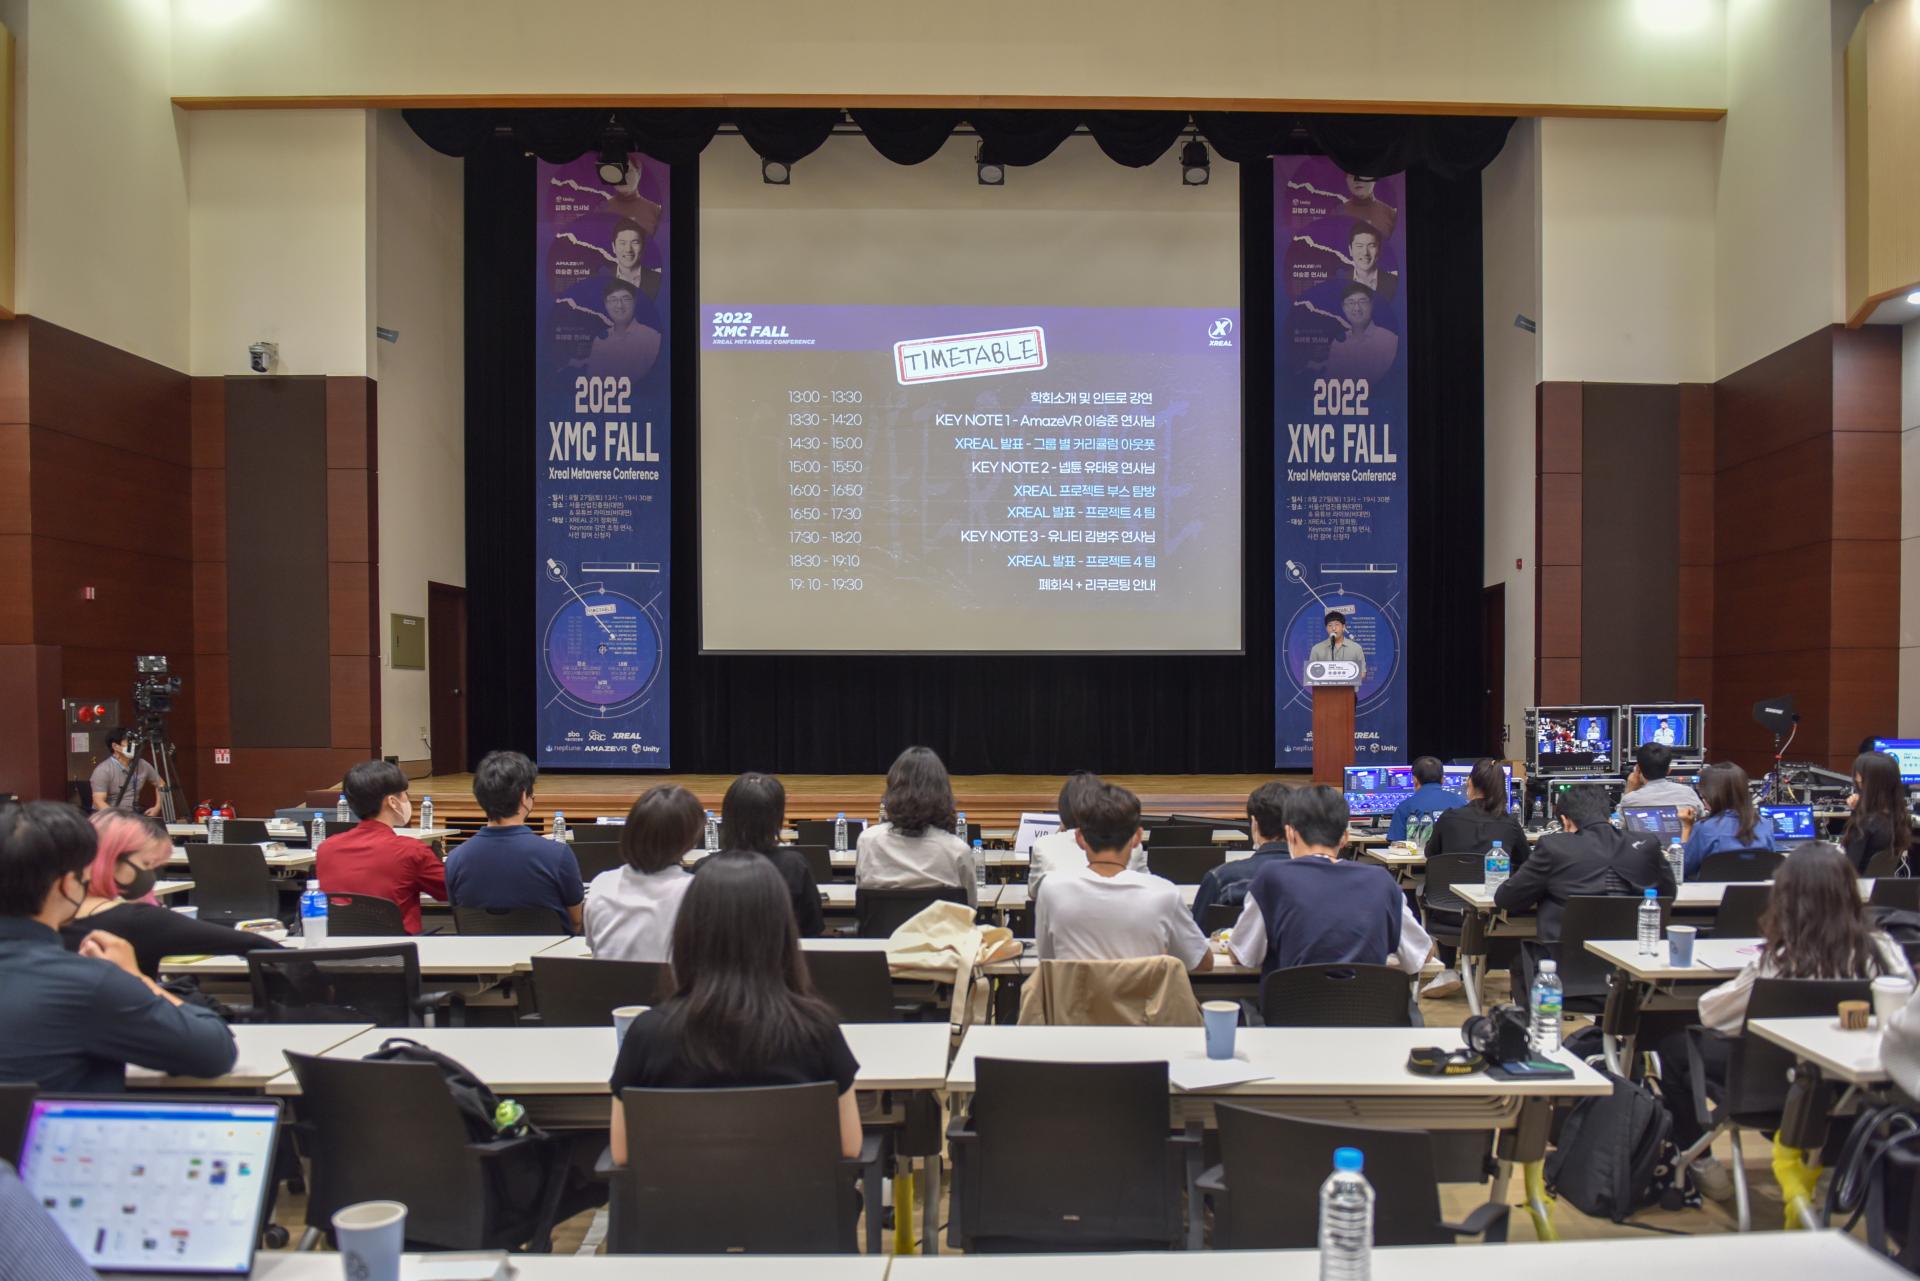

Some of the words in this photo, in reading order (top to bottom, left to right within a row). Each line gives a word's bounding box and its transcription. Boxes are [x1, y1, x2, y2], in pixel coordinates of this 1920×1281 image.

[713, 312, 752, 324] 2022
[712, 326, 748, 337] XMC
[750, 326, 789, 337] FALL
[904, 339, 1038, 370] TIMETABLE
[575, 376, 631, 414] 2022
[788, 390, 820, 403] 13:00
[831, 390, 862, 403] 13:30
[1030, 391, 1077, 404] 학회소개
[1079, 391, 1090, 404] 및
[1093, 391, 1128, 404] 인트로
[1129, 391, 1153, 404] 강연
[1314, 378, 1369, 416] 2022
[788, 413, 820, 426] 13:30
[831, 413, 862, 426] 14:20
[935, 414, 963, 426] KEY
[965, 414, 1003, 426] NOTE
[1005, 414, 1010, 426] 1
[1020, 414, 1082, 427] AmazeVR
[1084, 414, 1119, 427] 이승준
[1120, 414, 1155, 427] 연사님
[549, 421, 597, 462] XMC
[605, 421, 660, 462] FALL
[788, 437, 820, 449] 14:30
[832, 437, 863, 449] 15:00
[954, 437, 999, 450] XREAL
[1000, 437, 1024, 450] 발표
[1033, 437, 1056, 450] 그룹
[1059, 437, 1071, 450] 별
[1073, 437, 1119, 450] 커리큘럼
[1121, 437, 1156, 450] 아웃풋
[1287, 424, 1335, 463] XMC
[1344, 424, 1397, 463] FALL
[549, 467, 569, 480] Xreal
[571, 467, 611, 480] Metaverse
[613, 467, 659, 480] Conference
[789, 461, 820, 473] 15:00
[832, 461, 863, 473] 15:50
[972, 461, 999, 473] KEY
[1001, 461, 1039, 473] NOTE
[1041, 461, 1050, 474] 2
[1059, 461, 1082, 474] 넵튠
[1084, 461, 1119, 474] 유태웅
[1121, 461, 1155, 474] 연사님
[1287, 469, 1308, 482] Xreal
[1310, 469, 1350, 482] Metaverse
[1351, 469, 1397, 482] Conference
[789, 484, 820, 496] 16:00
[832, 484, 863, 496] 16:50
[1013, 484, 1057, 497] XREAL
[1059, 484, 1105, 497] 프로젝트
[1107, 484, 1131, 497] 부스
[1132, 484, 1156, 497] 탐방
[789, 507, 820, 520] 16:50
[832, 507, 862, 520] 17:30
[1007, 506, 1051, 519] XREAL
[1052, 506, 1076, 519] 발표
[1085, 506, 1132, 519] 프로젝트
[1133, 506, 1142, 519] 4
[1144, 506, 1156, 519] 팀
[790, 531, 820, 544] 17:30
[831, 531, 862, 544] 18:20
[961, 530, 988, 543] KEY
[990, 530, 1028, 543] NOTE
[1030, 530, 1039, 543] 3
[1048, 530, 1082, 543] 유니티
[1085, 530, 1119, 543] 김범주
[1121, 530, 1156, 543] 연사님
[790, 554, 821, 567] 18:30
[832, 554, 860, 567] 19:10
[1007, 555, 1051, 568] XREAL
[1052, 555, 1076, 568] 발표
[1085, 555, 1132, 568] 프로젝트
[1133, 555, 1142, 568] 4
[1144, 555, 1156, 568] 팀
[832, 578, 863, 591] 19:30
[1038, 578, 1073, 591] 폐회식
[1085, 578, 1130, 591] 리쿠르팅
[1132, 578, 1156, 591] 안내
[1445, 1065, 1472, 1074] Nikon
